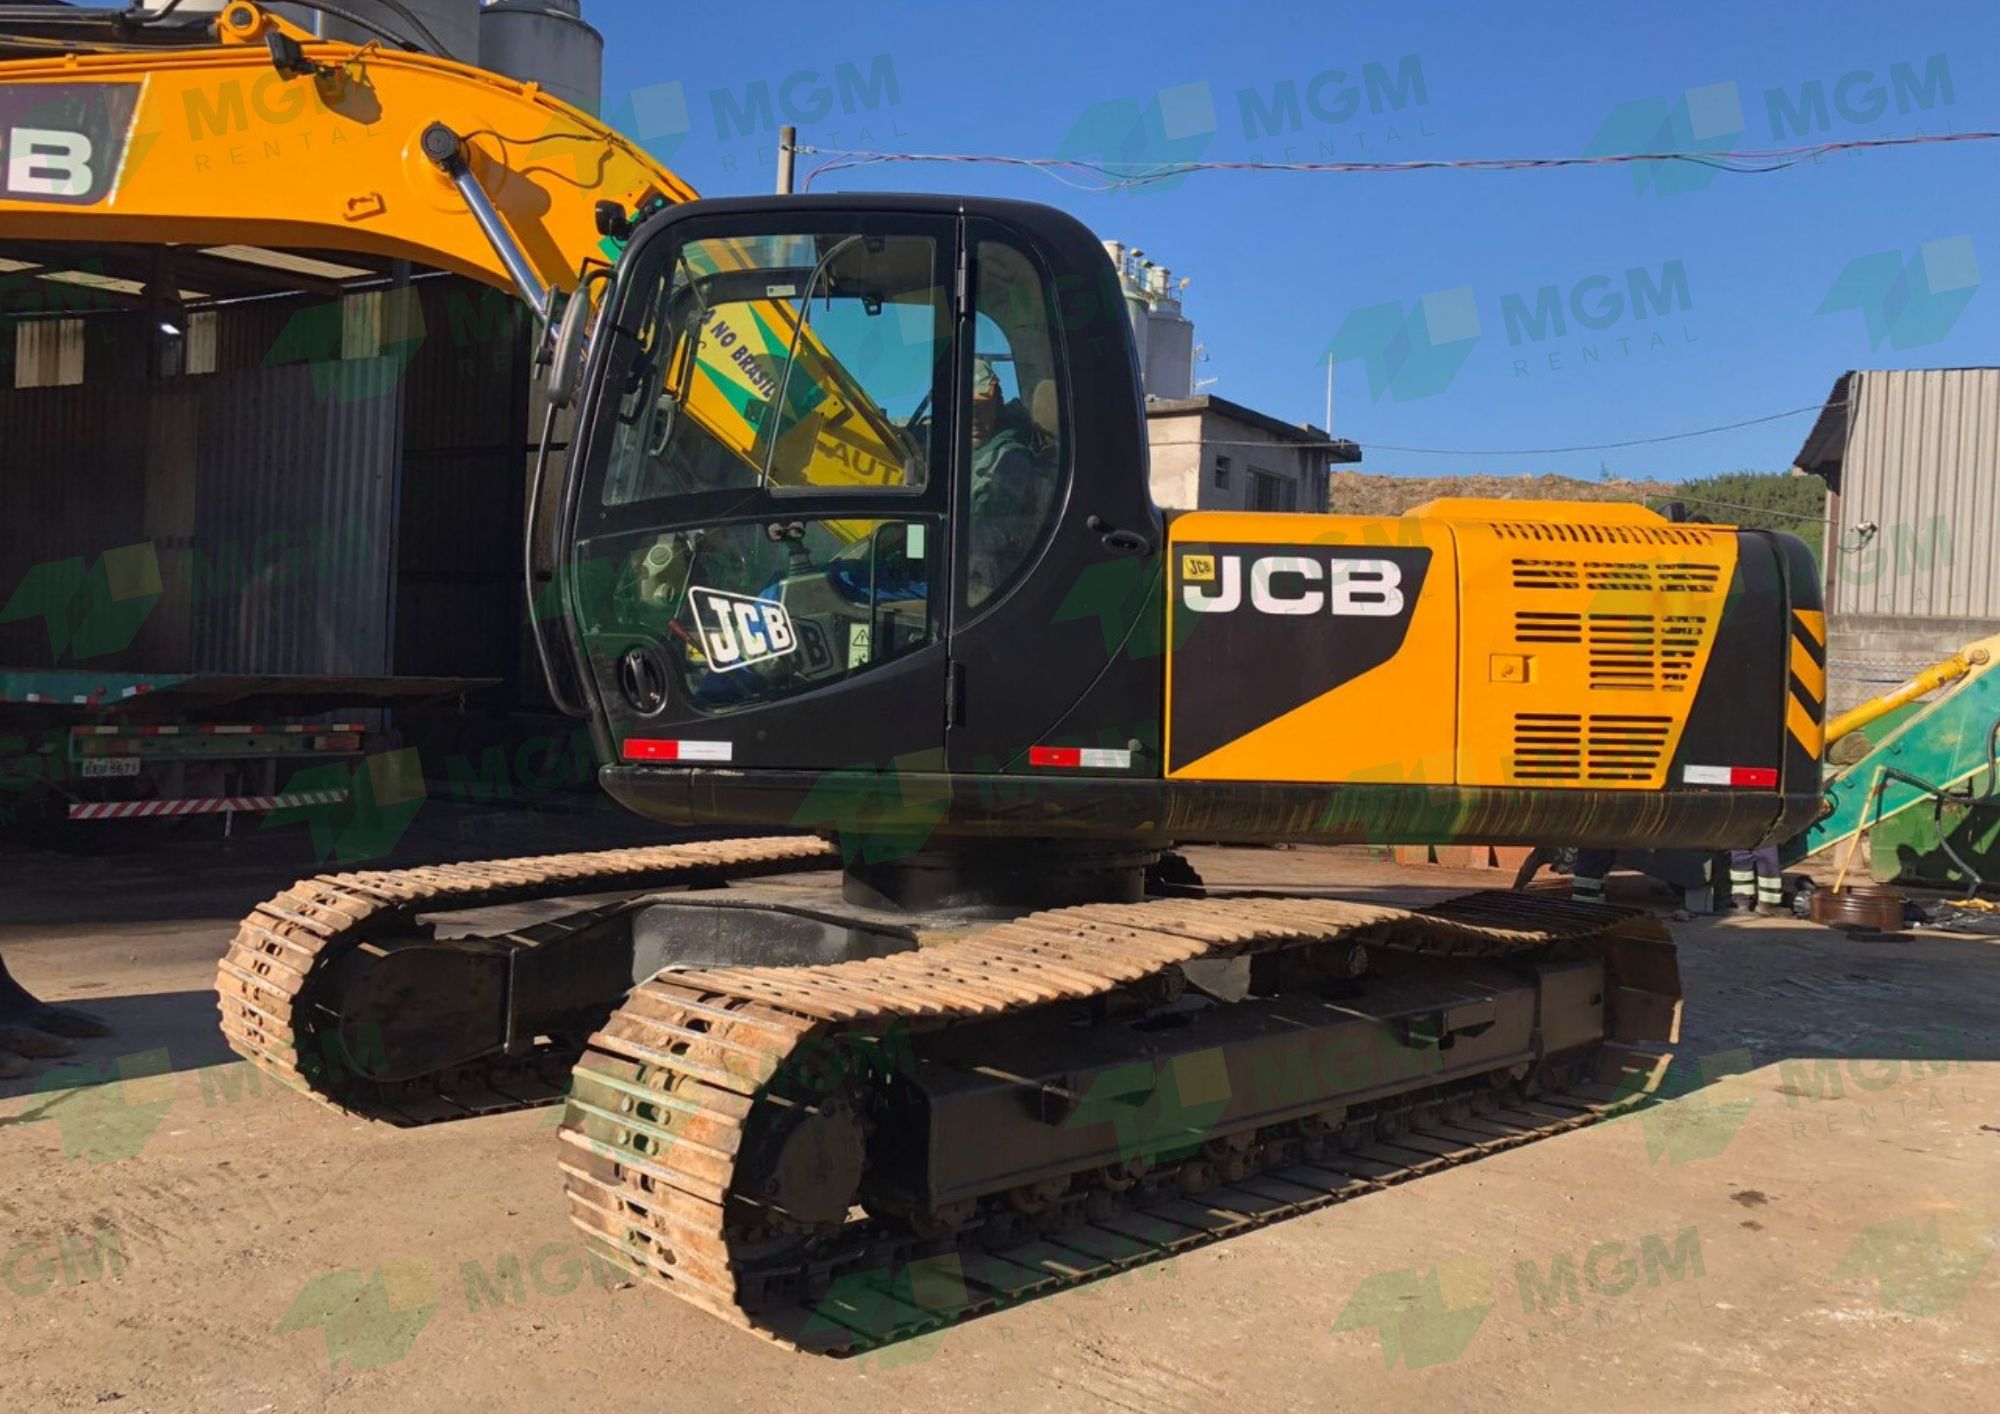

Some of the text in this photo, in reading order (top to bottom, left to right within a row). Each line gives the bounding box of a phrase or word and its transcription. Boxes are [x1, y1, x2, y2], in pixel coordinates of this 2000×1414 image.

[0, 127, 93, 196] B
[710, 320, 737, 348] NO
[731, 344, 775, 398] BRASIL
[1183, 556, 1404, 617] JCB
[708, 597, 790, 662] JCB
